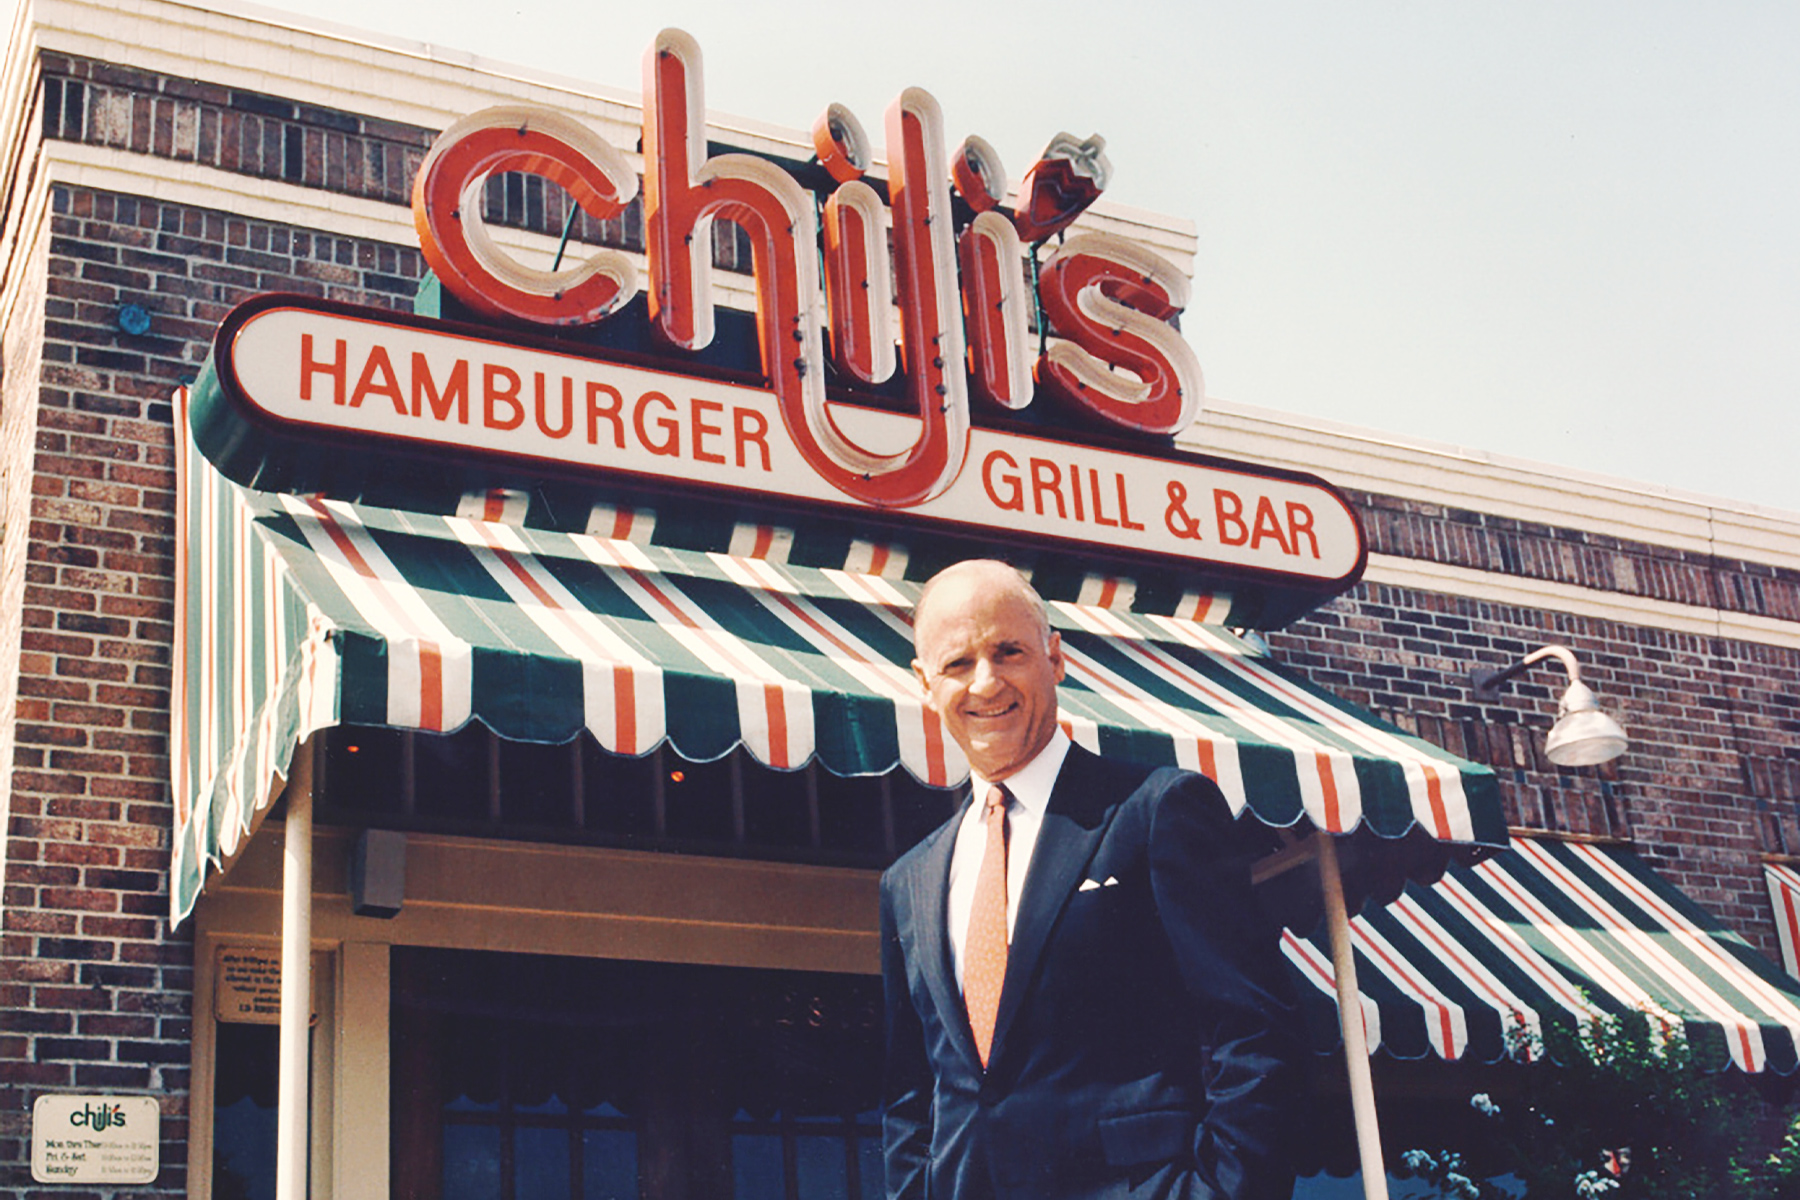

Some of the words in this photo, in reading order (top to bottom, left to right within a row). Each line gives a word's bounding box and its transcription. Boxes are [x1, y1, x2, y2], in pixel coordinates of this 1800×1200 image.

[299, 333, 772, 472] HAMBURGER
[981, 449, 1145, 532] GRILL
[1164, 480, 1203, 541] &
[1212, 488, 1322, 560] BAR
